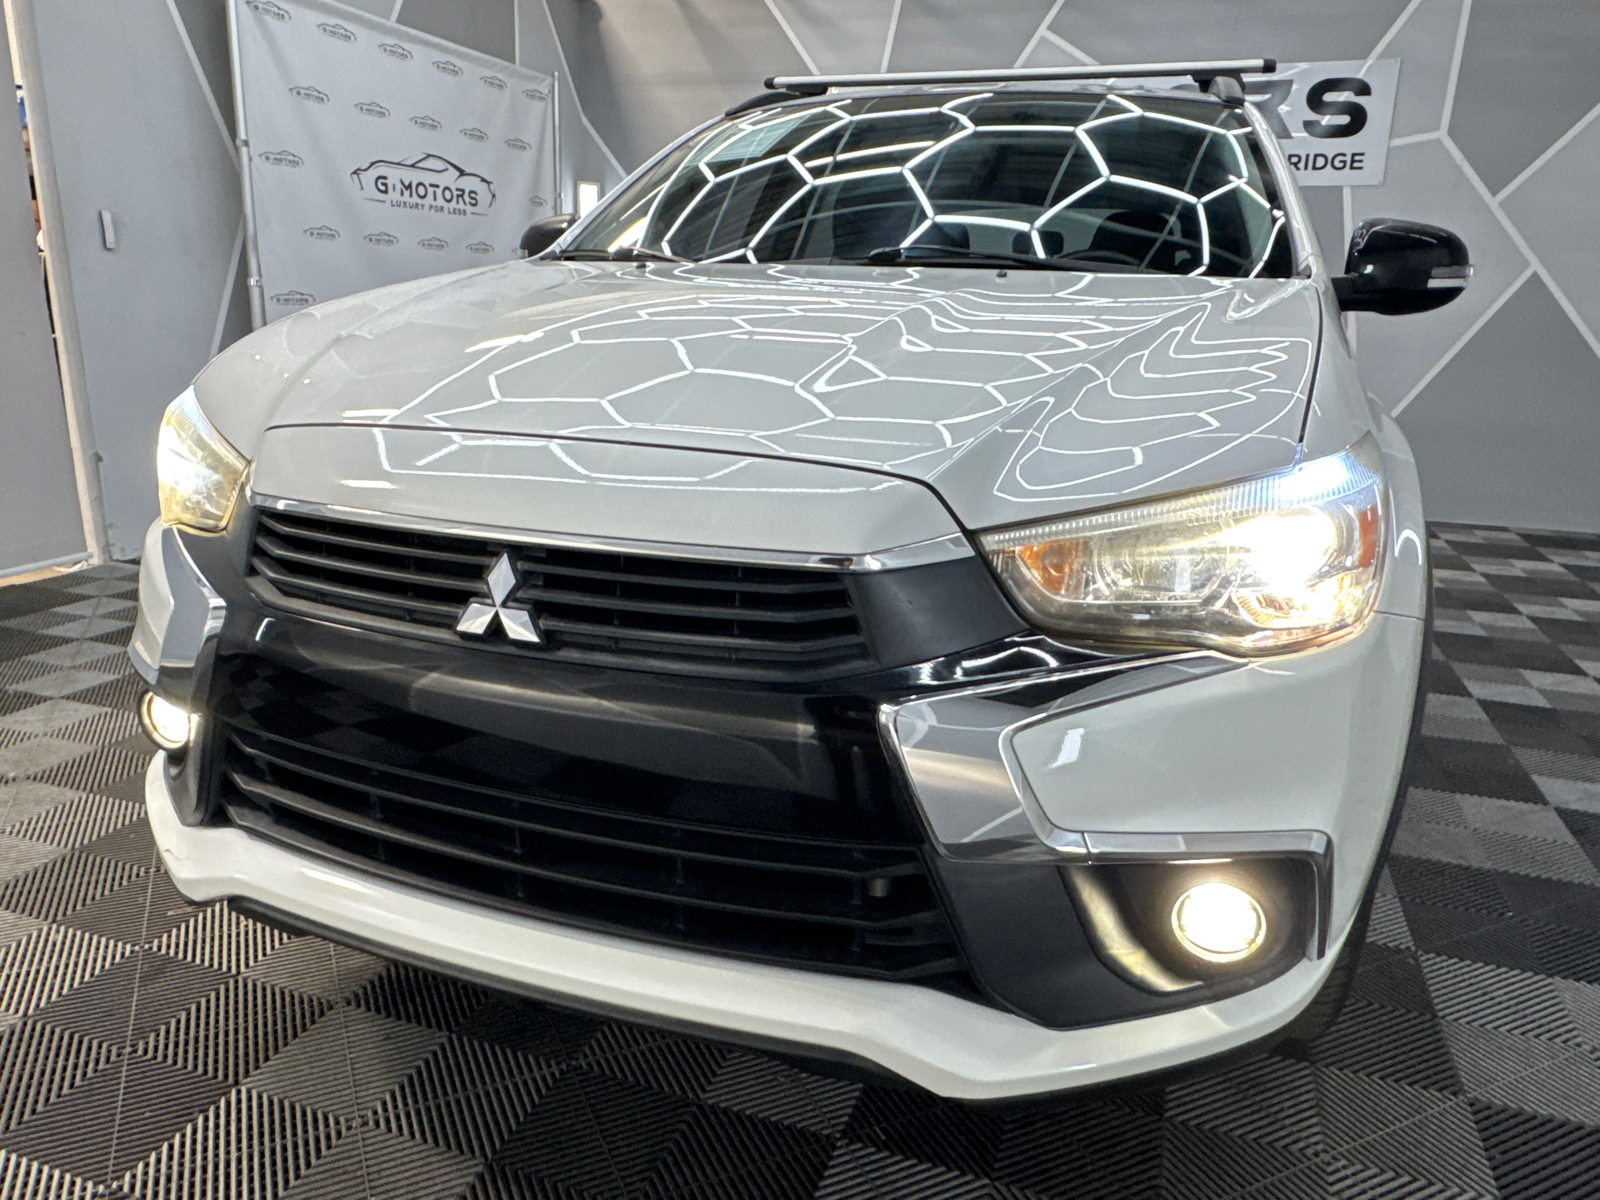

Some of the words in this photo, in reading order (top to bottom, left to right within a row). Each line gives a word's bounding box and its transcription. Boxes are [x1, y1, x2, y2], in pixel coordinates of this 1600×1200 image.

[261, 7, 285, 20] MOTORS
[328, 30, 351, 41] MOTORS
[389, 49, 408, 60] MOTORS
[303, 92, 324, 102] MOTORS
[365, 107, 386, 117] MOTORS
[273, 157, 300, 166] MOTORS
[400, 178, 479, 207] MOTORS
[390, 199, 425, 211] LUXURY
[428, 205, 445, 213] FOR
[447, 207, 467, 216] LESS
